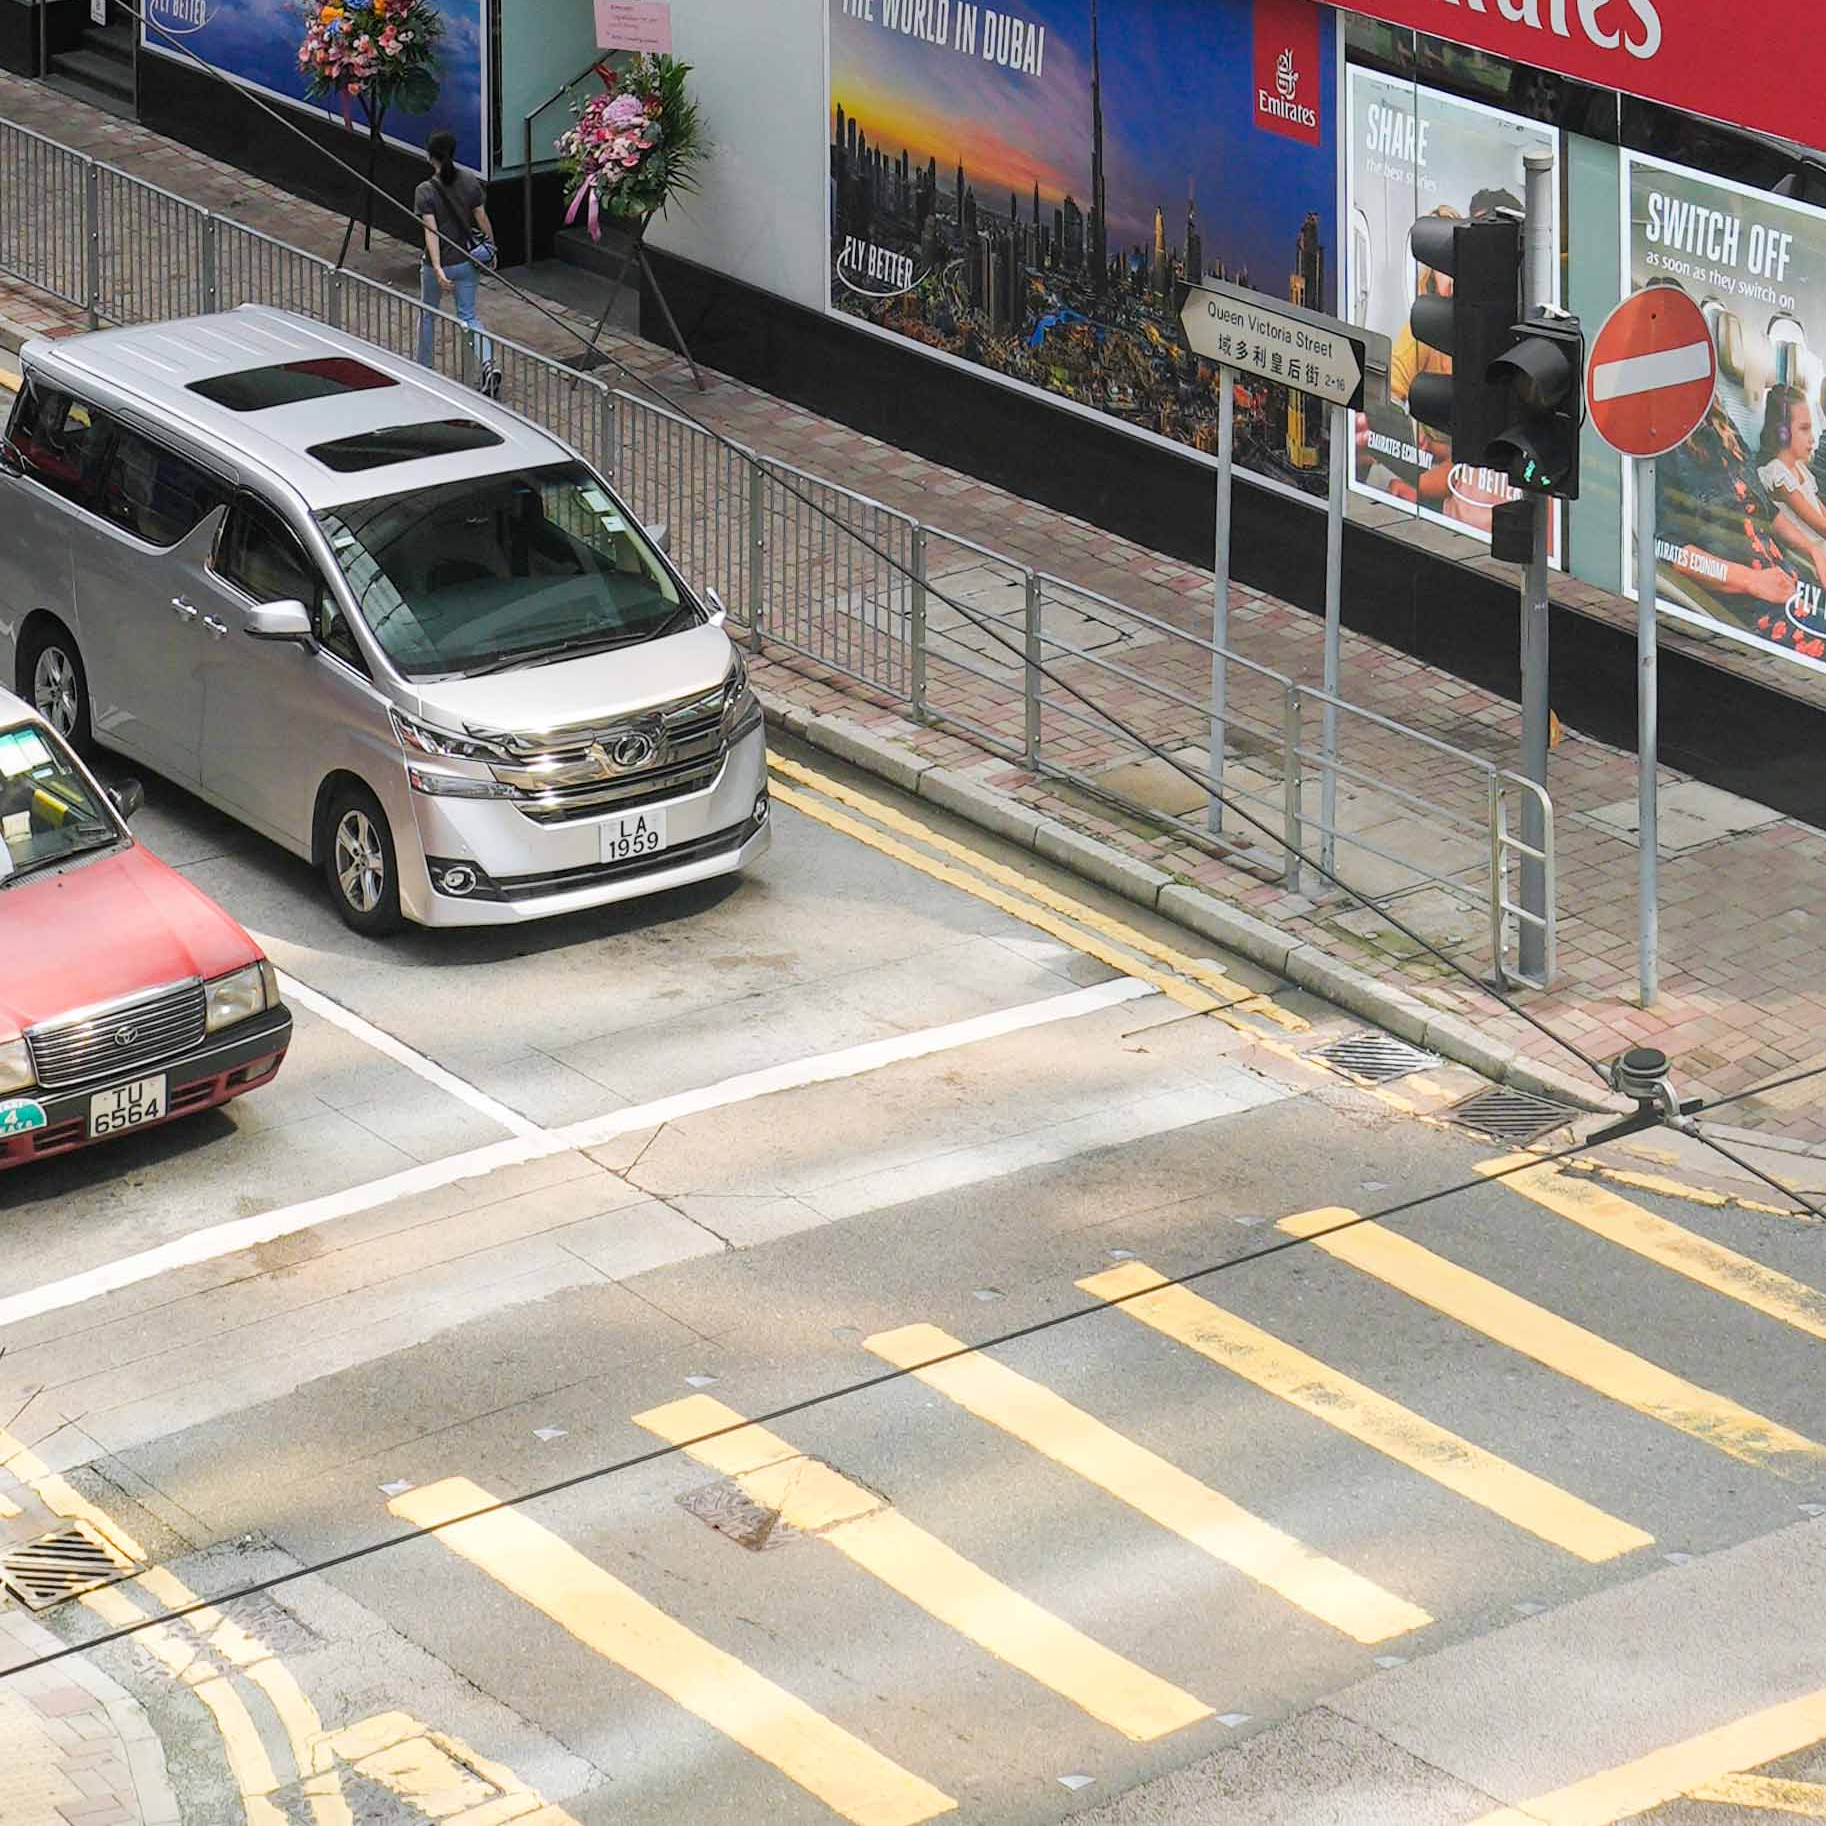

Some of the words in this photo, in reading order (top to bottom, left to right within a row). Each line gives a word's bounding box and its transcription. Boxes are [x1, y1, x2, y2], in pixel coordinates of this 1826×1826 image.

[954, 0, 979, 55] IN
[983, 10, 1045, 78] DUBAI
[1258, 89, 1316, 127] Emirates
[1366, 103, 1430, 166] SHARE
[1646, 191, 1741, 268] SWITCH
[1748, 224, 1793, 283] OFF
[843, 235, 866, 272] FLY
[868, 244, 914, 290] BETTER
[1646, 251, 1659, 266] as
[1661, 256, 1691, 276] soon
[1693, 267, 1706, 282] as
[1709, 267, 1736, 294] they
[1737, 281, 1776, 304] switch
[1778, 294, 1796, 310] on
[1207, 300, 1245, 328] Queen
[1248, 314, 1293, 344] Victoria
[1296, 330, 1333, 359] Street
[1217, 332, 1321, 388] 域多利皇后街
[1367, 430, 1402, 459] EMIRATES
[1689, 551, 1729, 582] ECONOMY
[1794, 580, 1821, 617] FLY
[609, 831, 659, 859] 1959
[621, 815, 647, 838] LA
[112, 1083, 144, 1110] TU
[95, 1099, 159, 1135] 6564
